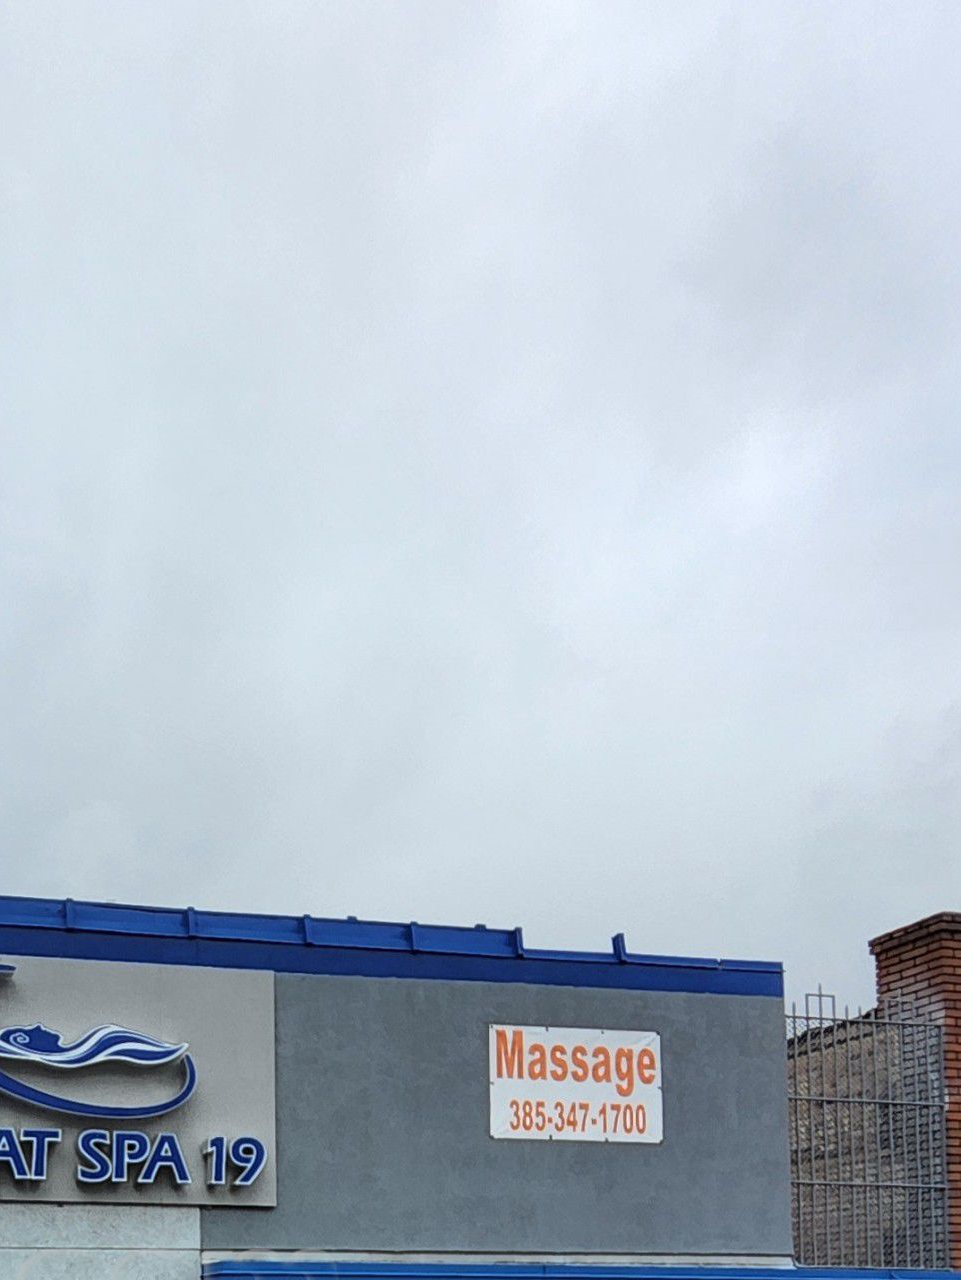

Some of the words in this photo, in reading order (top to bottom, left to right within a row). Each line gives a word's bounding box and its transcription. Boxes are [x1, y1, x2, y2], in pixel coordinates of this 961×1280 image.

[495, 1029, 657, 1097] Massage
[509, 1099, 647, 1135] 385-347-1700
[76, 1128, 192, 1186] SPA
[202, 1135, 268, 1187] 19
